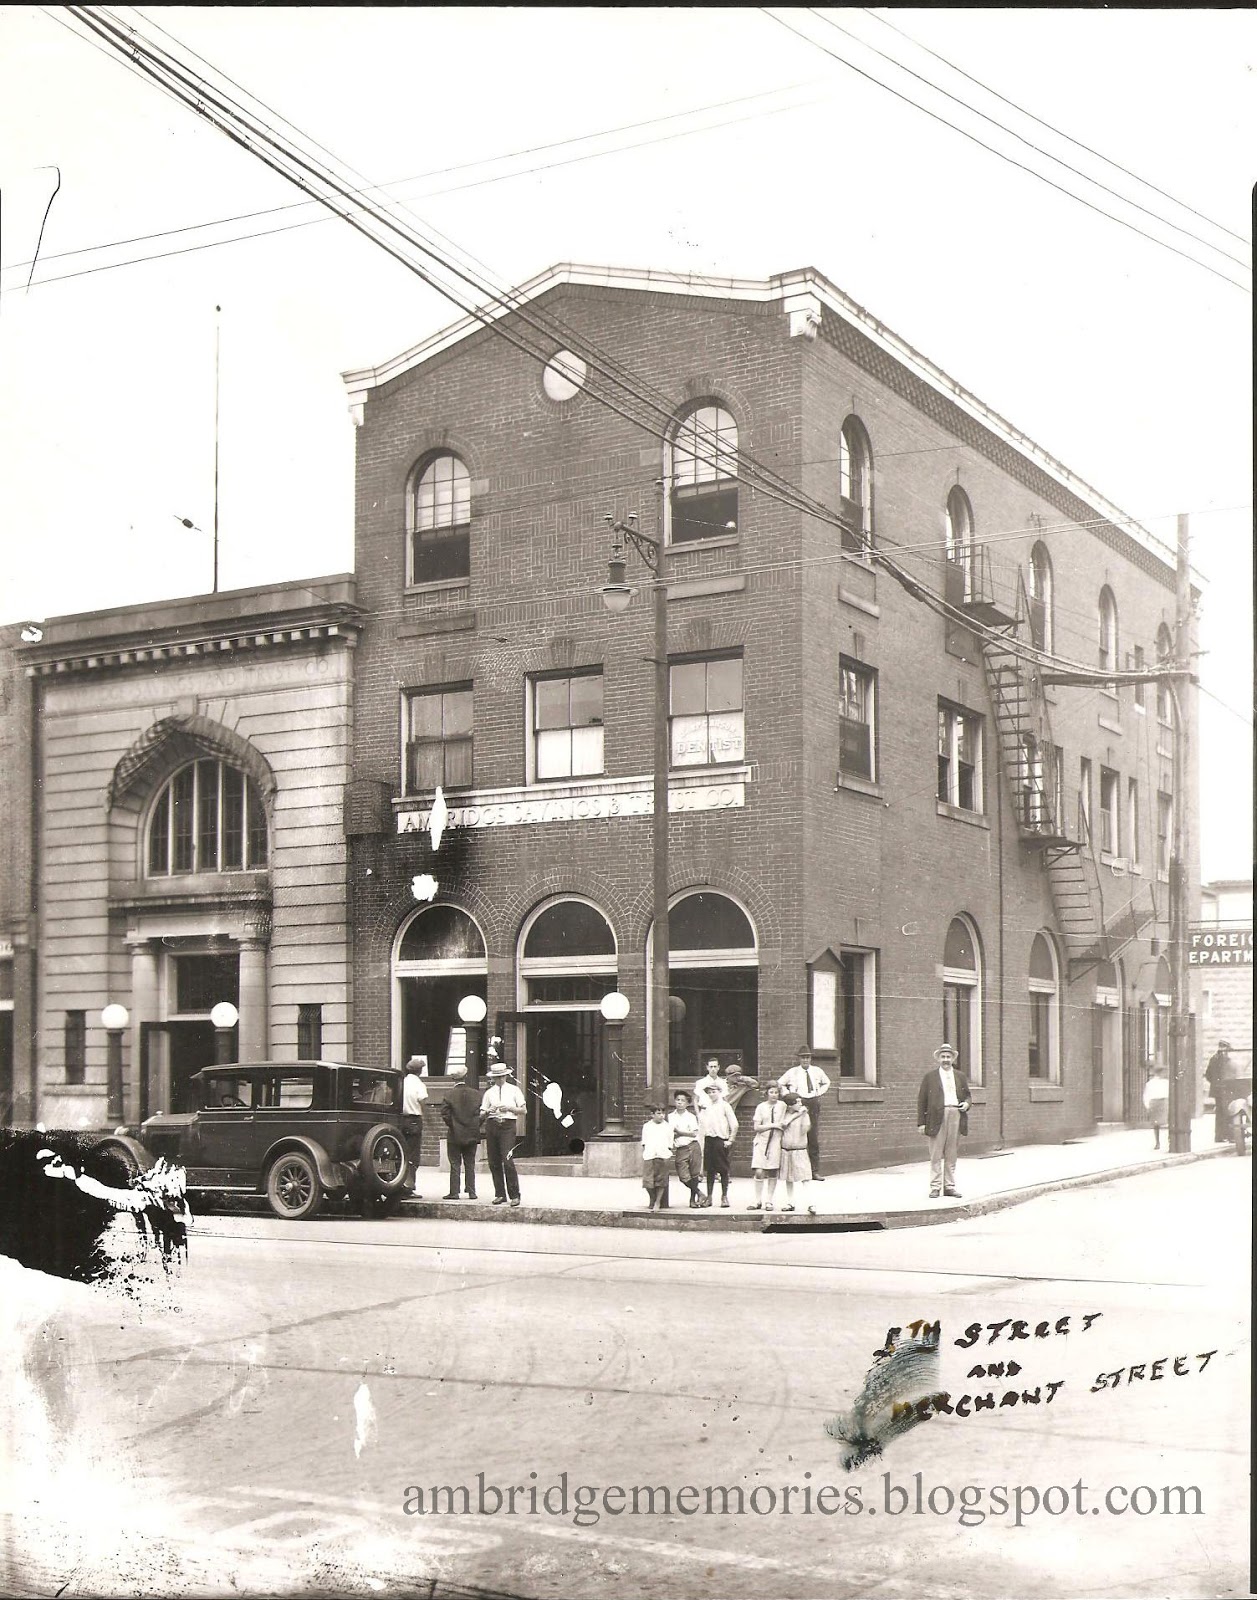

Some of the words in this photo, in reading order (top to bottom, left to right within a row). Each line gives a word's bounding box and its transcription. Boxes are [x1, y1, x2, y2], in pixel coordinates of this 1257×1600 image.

[676, 737, 742, 755] DENTIST
[403, 806, 506, 831] AMRIDGE
[514, 798, 602, 823] SAVINGS
[629, 790, 698, 813] TRST
[954, 1312, 1103, 1349] STREET
[967, 1360, 1022, 1379] AND
[1090, 1349, 1218, 1393] STREET
